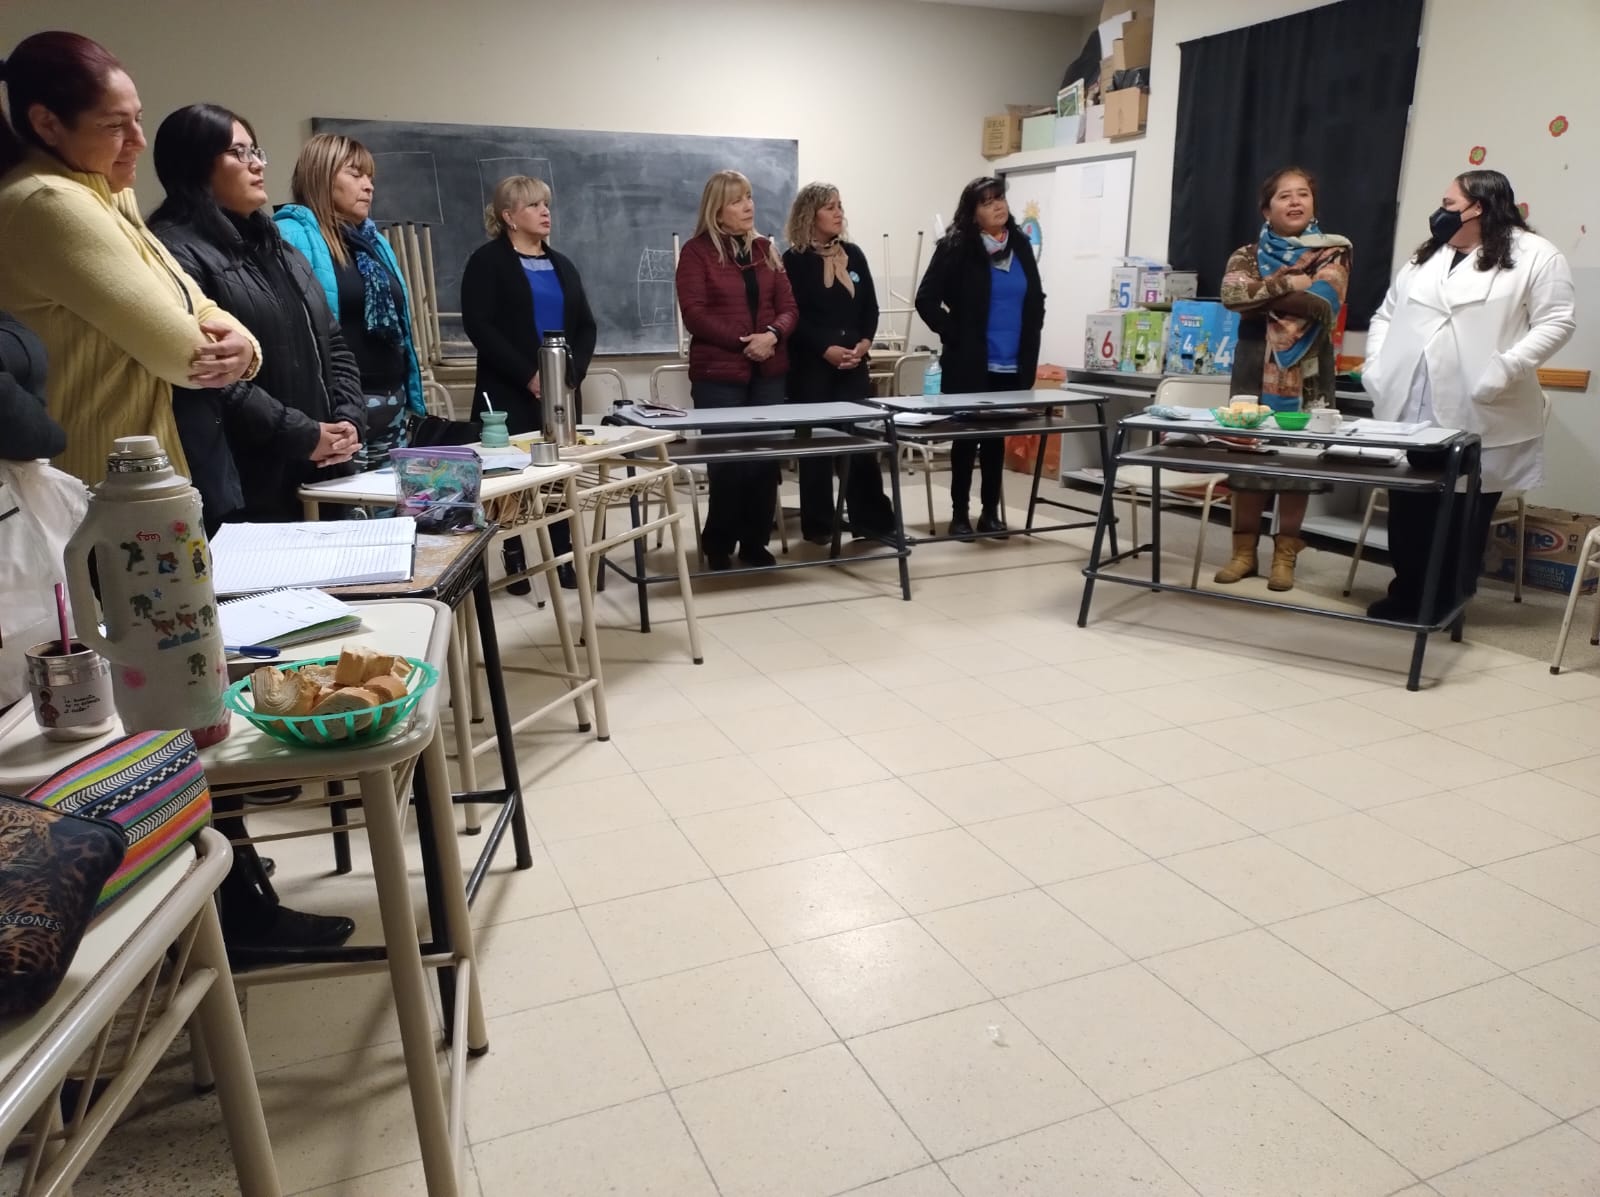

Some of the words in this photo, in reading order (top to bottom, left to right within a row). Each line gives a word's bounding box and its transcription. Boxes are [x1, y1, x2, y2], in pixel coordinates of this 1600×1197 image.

[1119, 282, 1130, 308] 5
[1102, 331, 1113, 358] 6
[1136, 335, 1145, 353] 4
[1183, 334, 1194, 353] 4
[1214, 336, 1231, 367] 4
